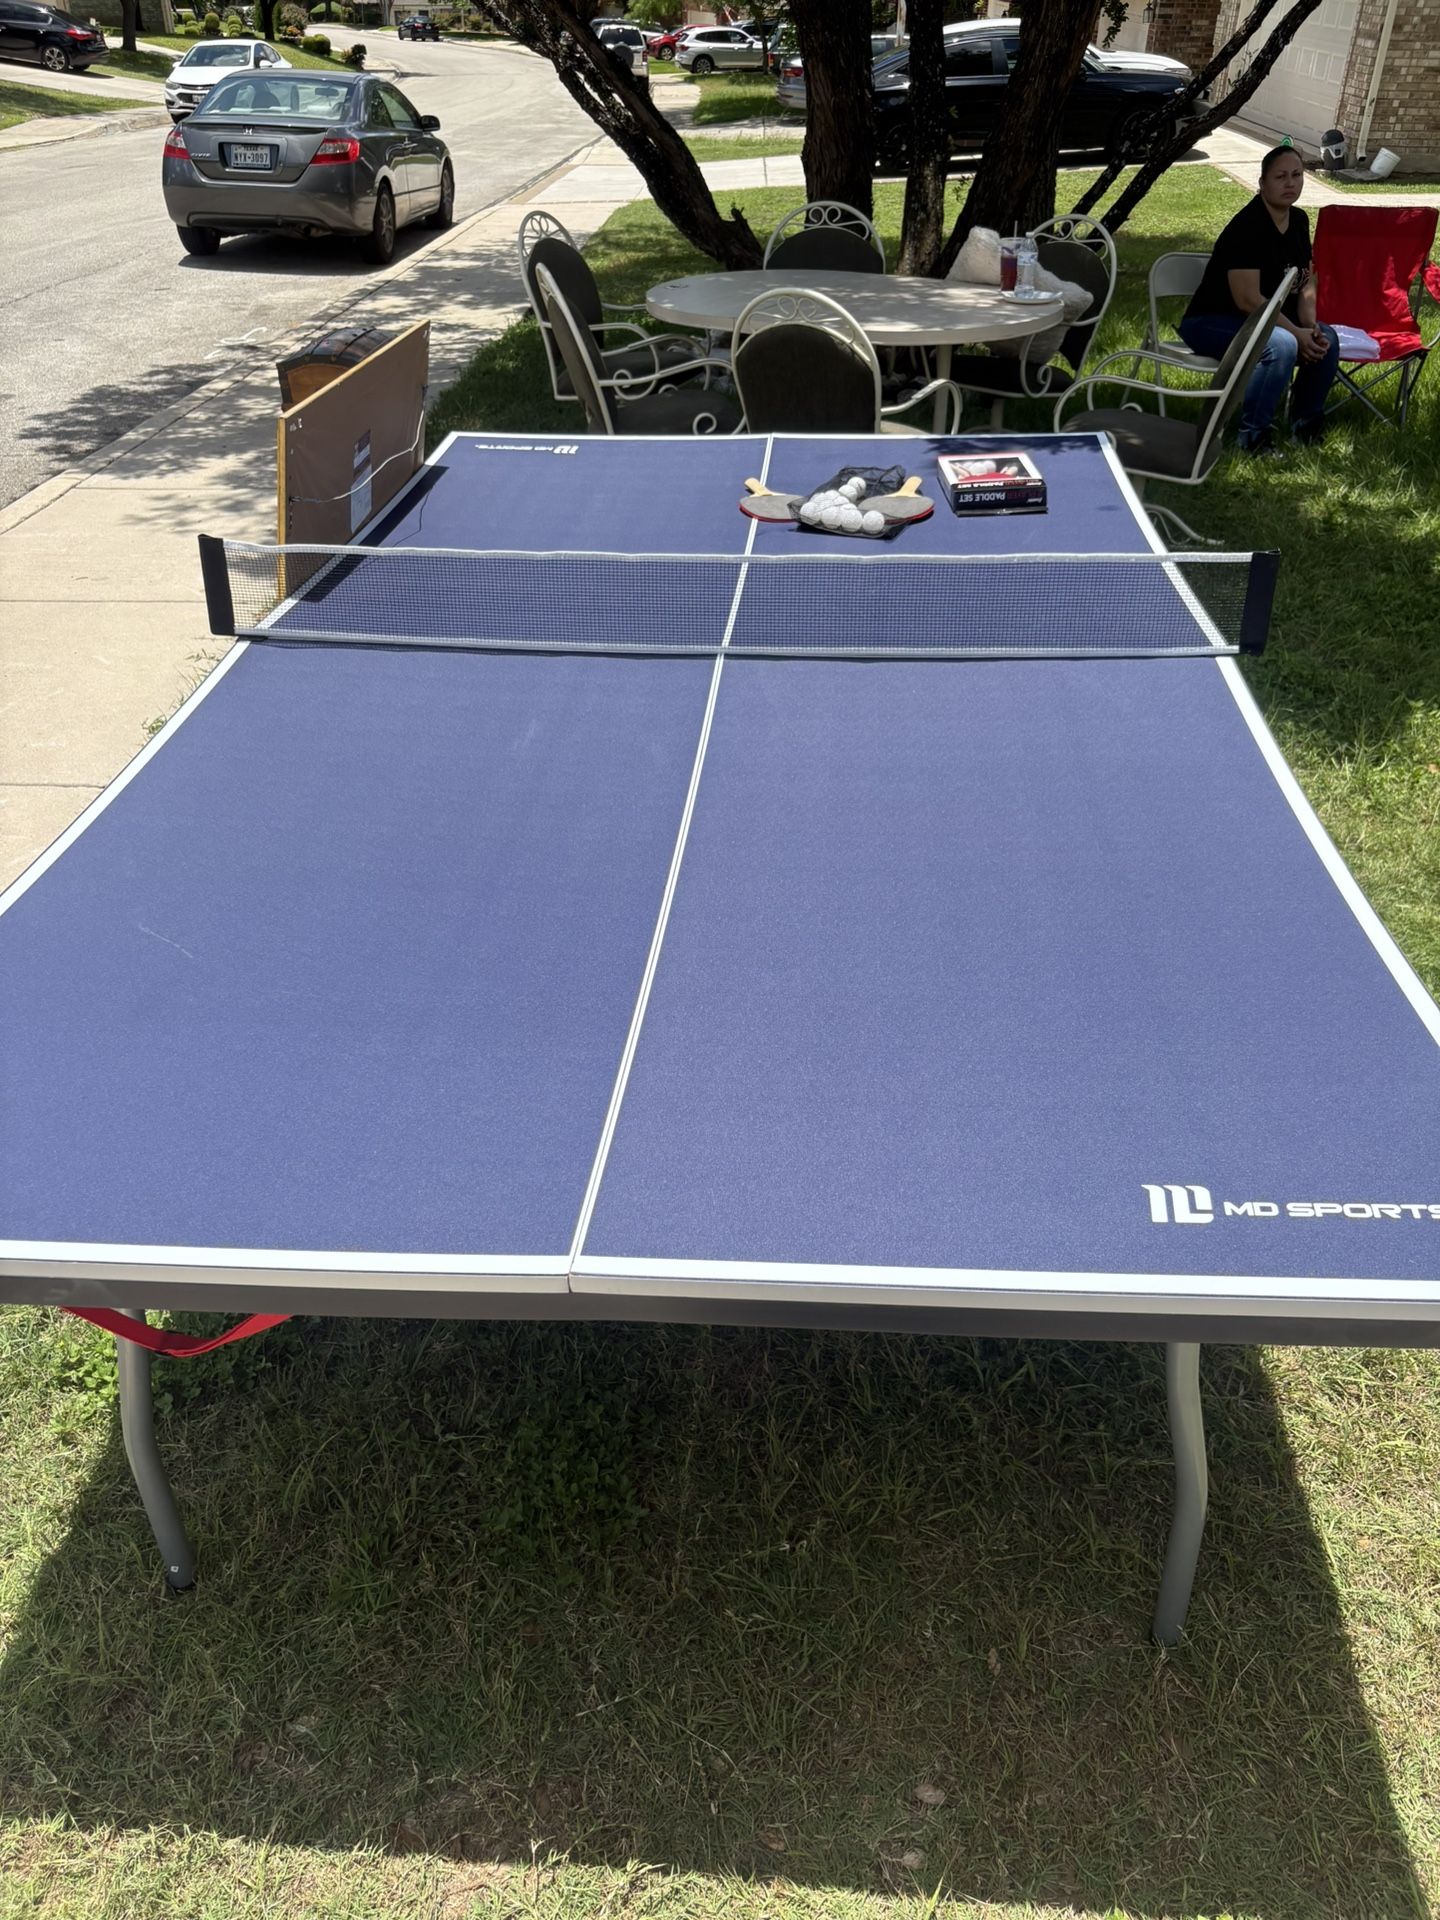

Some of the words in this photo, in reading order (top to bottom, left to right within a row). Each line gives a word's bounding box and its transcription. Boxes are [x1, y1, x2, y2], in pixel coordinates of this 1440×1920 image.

[959, 494, 973, 503] SET
[974, 492, 1005, 502] PADDLE
[1223, 1201, 1279, 1216] MD
